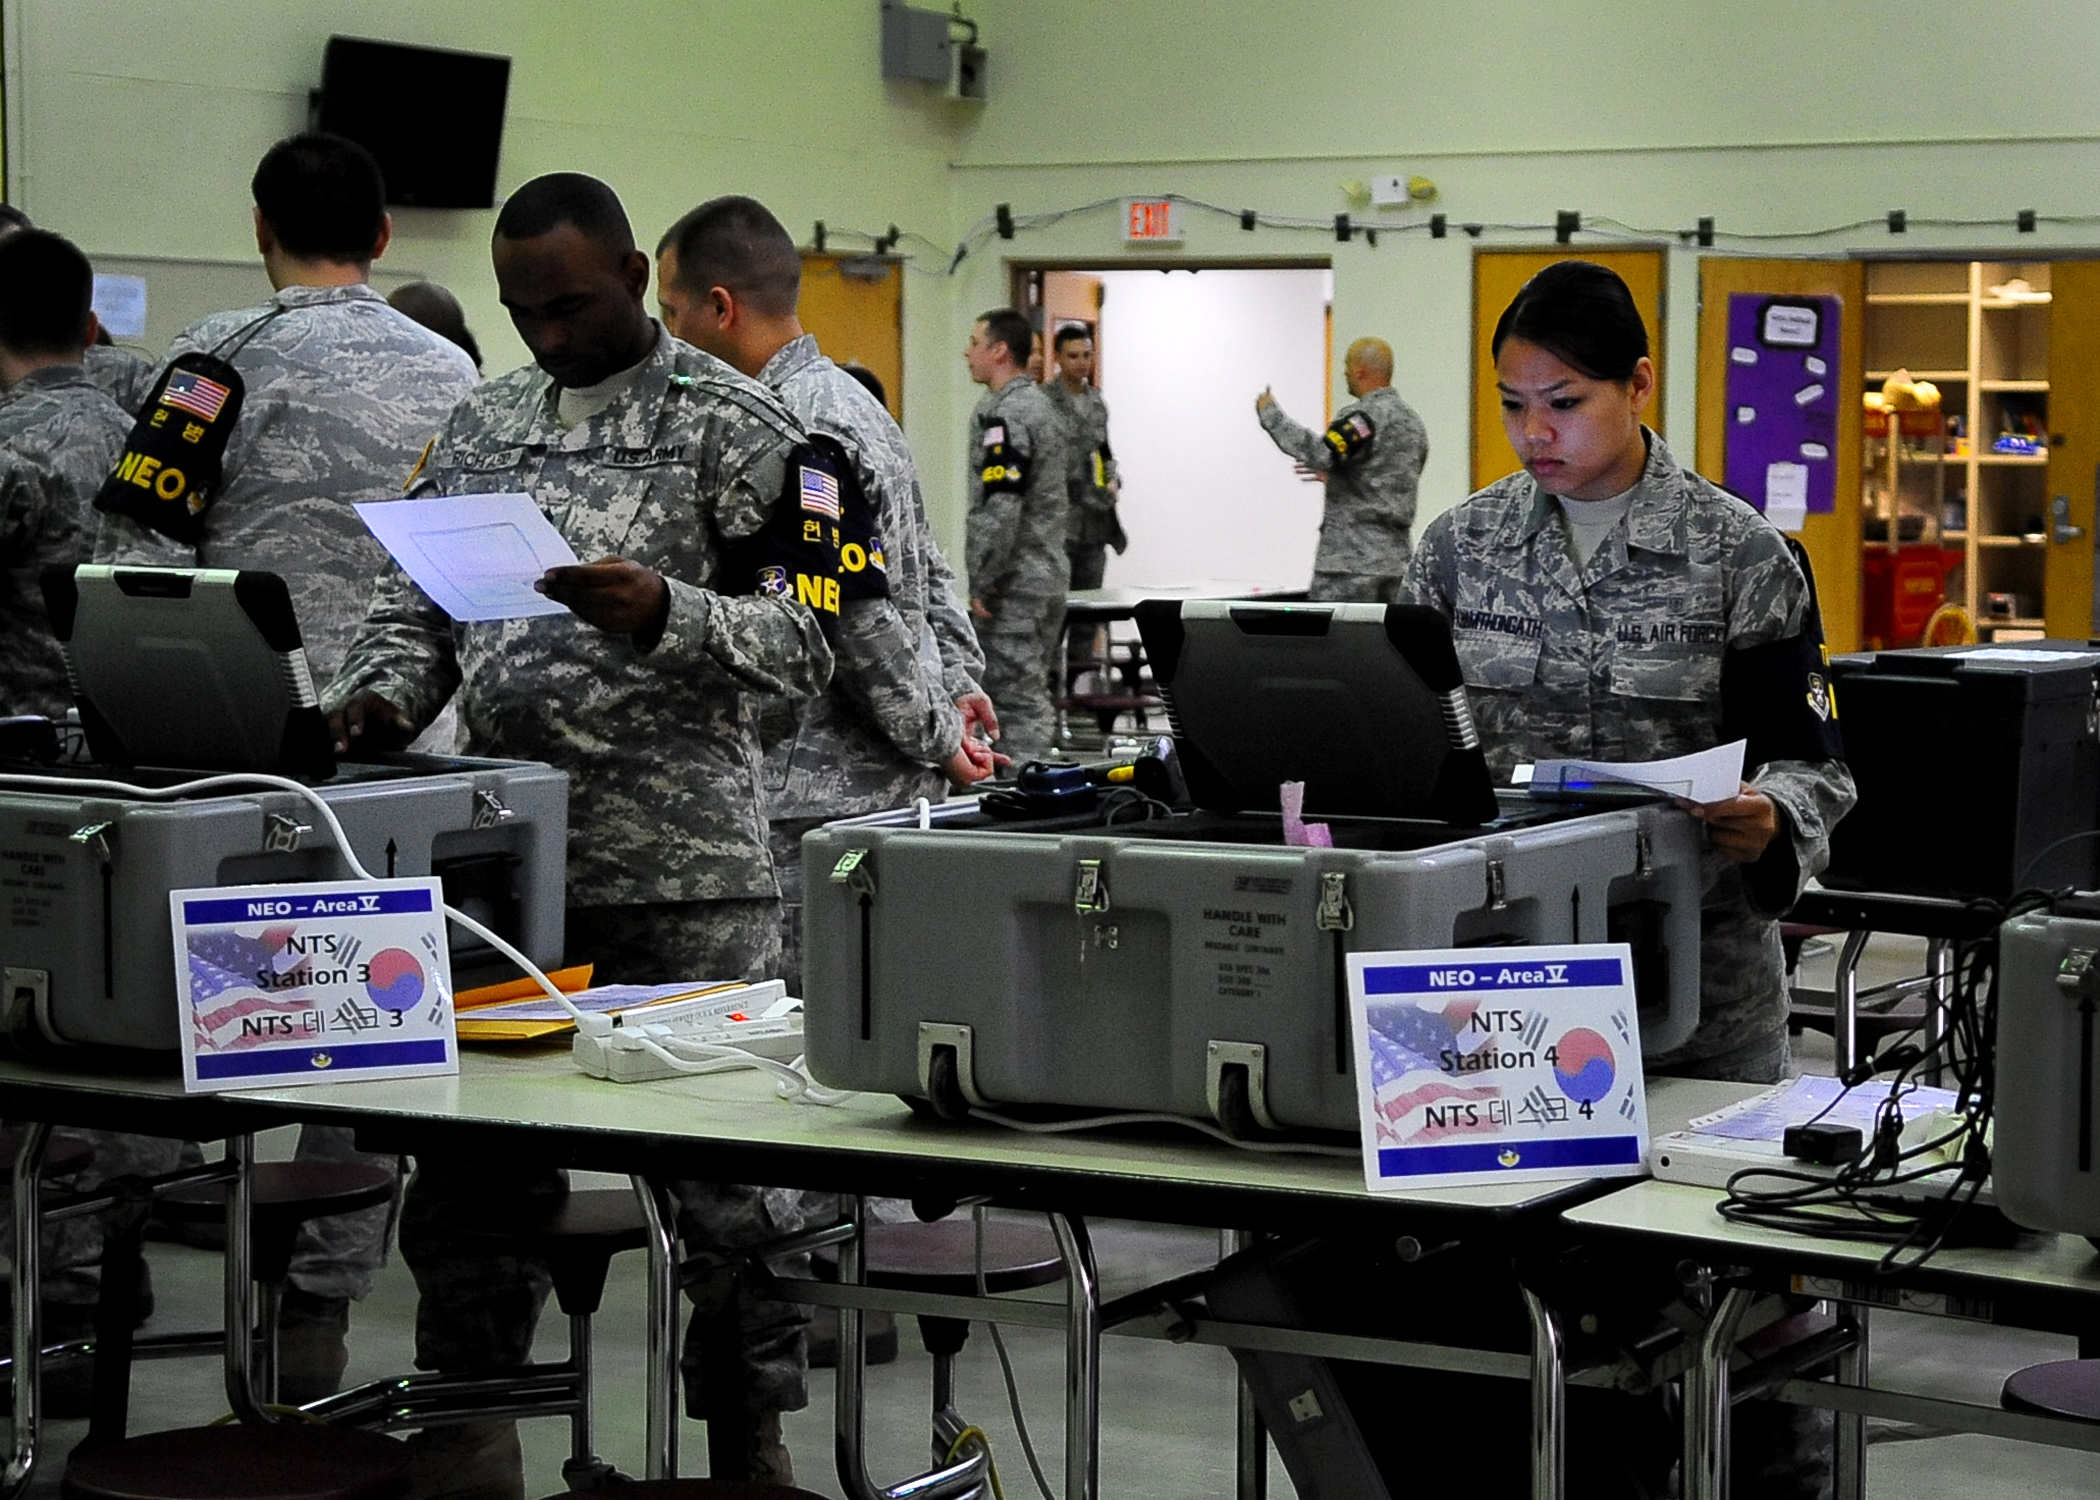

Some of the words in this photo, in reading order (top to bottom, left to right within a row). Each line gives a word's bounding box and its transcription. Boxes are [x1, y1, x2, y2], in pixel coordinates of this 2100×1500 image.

[642, 444, 686, 462] ARMY
[116, 451, 186, 500] NEO
[796, 573, 840, 616] NE
[1650, 624, 1676, 642] AIR
[1680, 625, 1725, 644] FORCE
[247, 901, 292, 917] NEO
[1203, 908, 1252, 923] HANDLE
[1257, 912, 1286, 926] WITH
[1229, 924, 1261, 938] CARE
[286, 934, 337, 955] NTS
[256, 965, 348, 990] Station
[356, 964, 371, 983] 3
[1429, 969, 1475, 987] NEO
[241, 1015, 293, 1038] NTS
[302, 1008, 380, 1034] 데스크
[389, 1008, 404, 1029] 3
[1471, 1010, 1523, 1033] NTS
[1440, 1048, 1535, 1072] Station
[1544, 1046, 1560, 1067] 4
[1425, 1104, 1479, 1129] NTS
[1489, 1097, 1569, 1126] 데스크
[1579, 1099, 1595, 1121] 4
